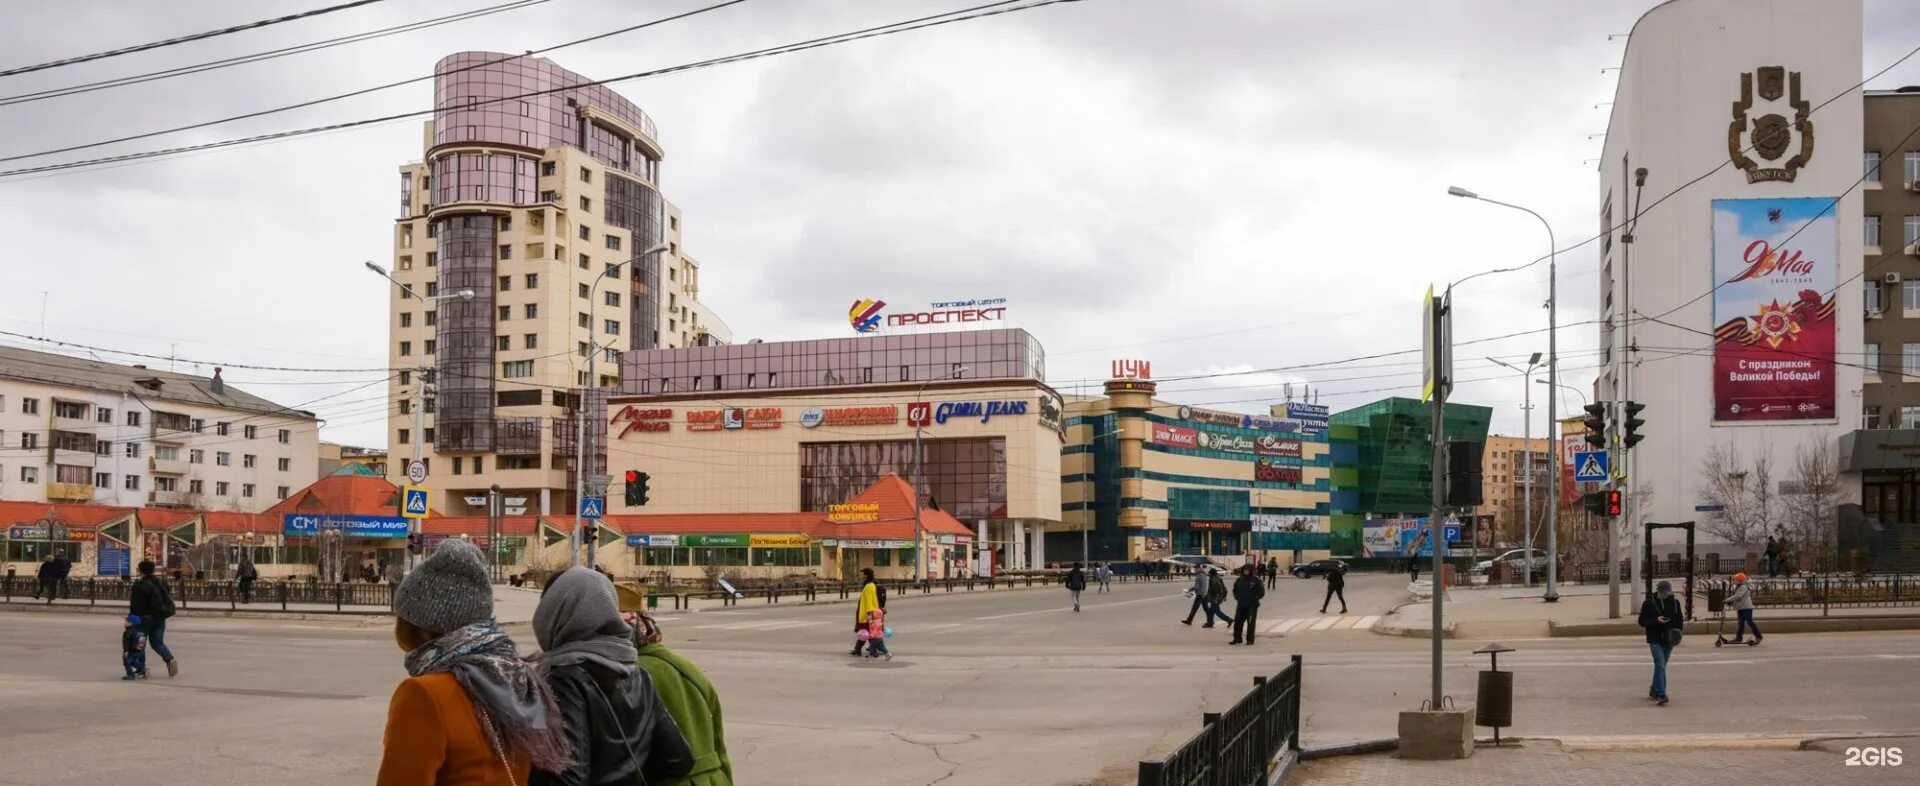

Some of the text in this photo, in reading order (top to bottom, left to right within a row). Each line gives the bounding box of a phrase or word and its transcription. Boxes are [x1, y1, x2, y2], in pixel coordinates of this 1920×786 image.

[1727, 240, 1815, 284] 9 Мая
[931, 297, 1007, 309] ТОРГОВЫЙ ЦЕНТР
[887, 308, 1007, 327] ПРОСПЕКТ
[1112, 359, 1151, 380] ЦУМ
[1739, 360, 1812, 372] С праздником
[1730, 371, 1821, 382] Великой Победы!
[803, 413, 819, 421] DNS
[910, 406, 927, 422] GJ
[935, 402, 982, 425] GLORIA
[980, 401, 1029, 424] JEANS
[1171, 434, 1194, 444] IMAGE
[411, 466, 423, 478] 50
[828, 501, 880, 512] ТОРГОВЫЙ
[292, 516, 318, 529] СМ
[828, 512, 879, 522] КОМПЛЕКС
[1447, 528, 1456, 539] P
[751, 537, 788, 545] Постельное
